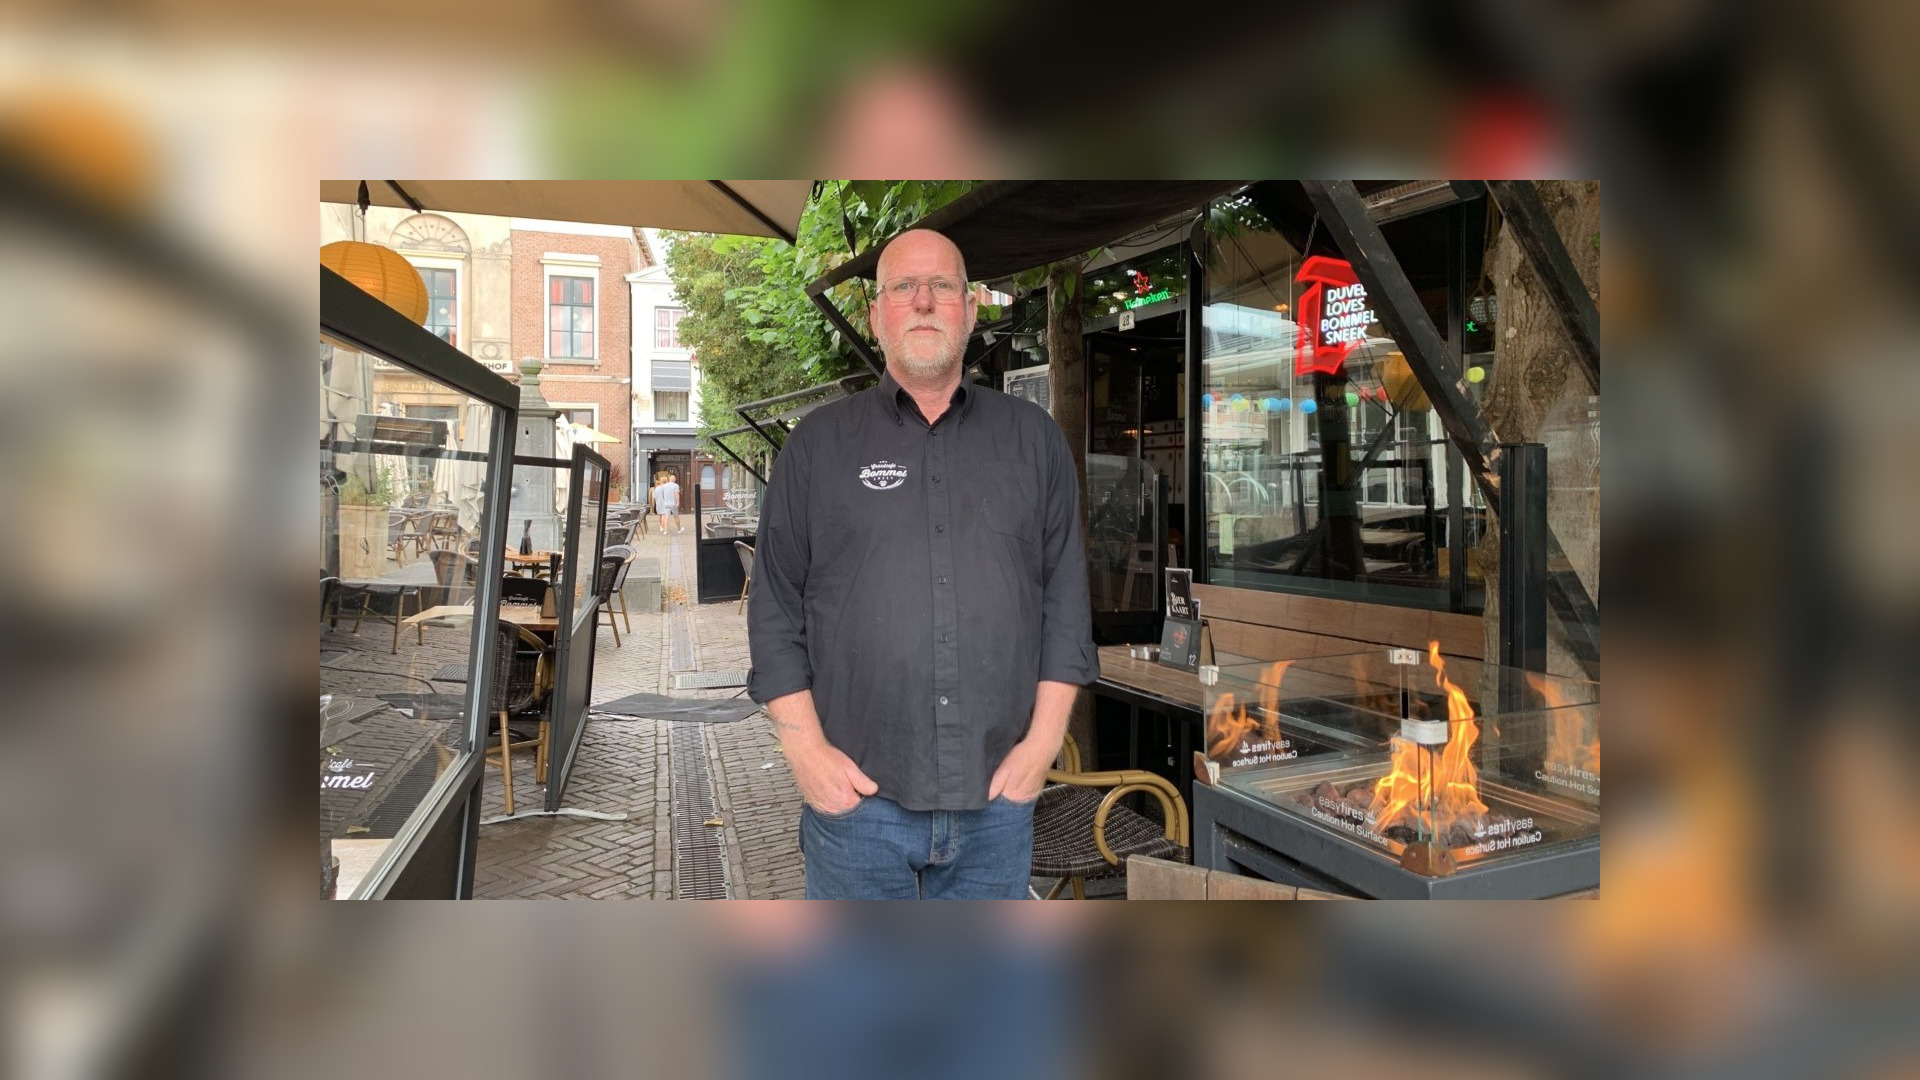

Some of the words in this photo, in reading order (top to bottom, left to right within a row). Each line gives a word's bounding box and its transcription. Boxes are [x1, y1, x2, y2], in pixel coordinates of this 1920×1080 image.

[1124, 290, 1169, 310] Heineken
[1327, 283, 1367, 302] DUVEL
[1326, 298, 1365, 316] LOVES
[1321, 310, 1378, 332] BOMMEL
[1325, 325, 1367, 344] SNEEK
[859, 469, 908, 479] Bommel
[1189, 654, 1196, 666] 12
[1535, 770, 1568, 787] Caution
[1570, 780, 1585, 792] Hot
[1319, 796, 1364, 821] easyfires
[1311, 806, 1340, 826] Caution
[1341, 818, 1356, 833] Hot
[1356, 825, 1389, 846] Surface
